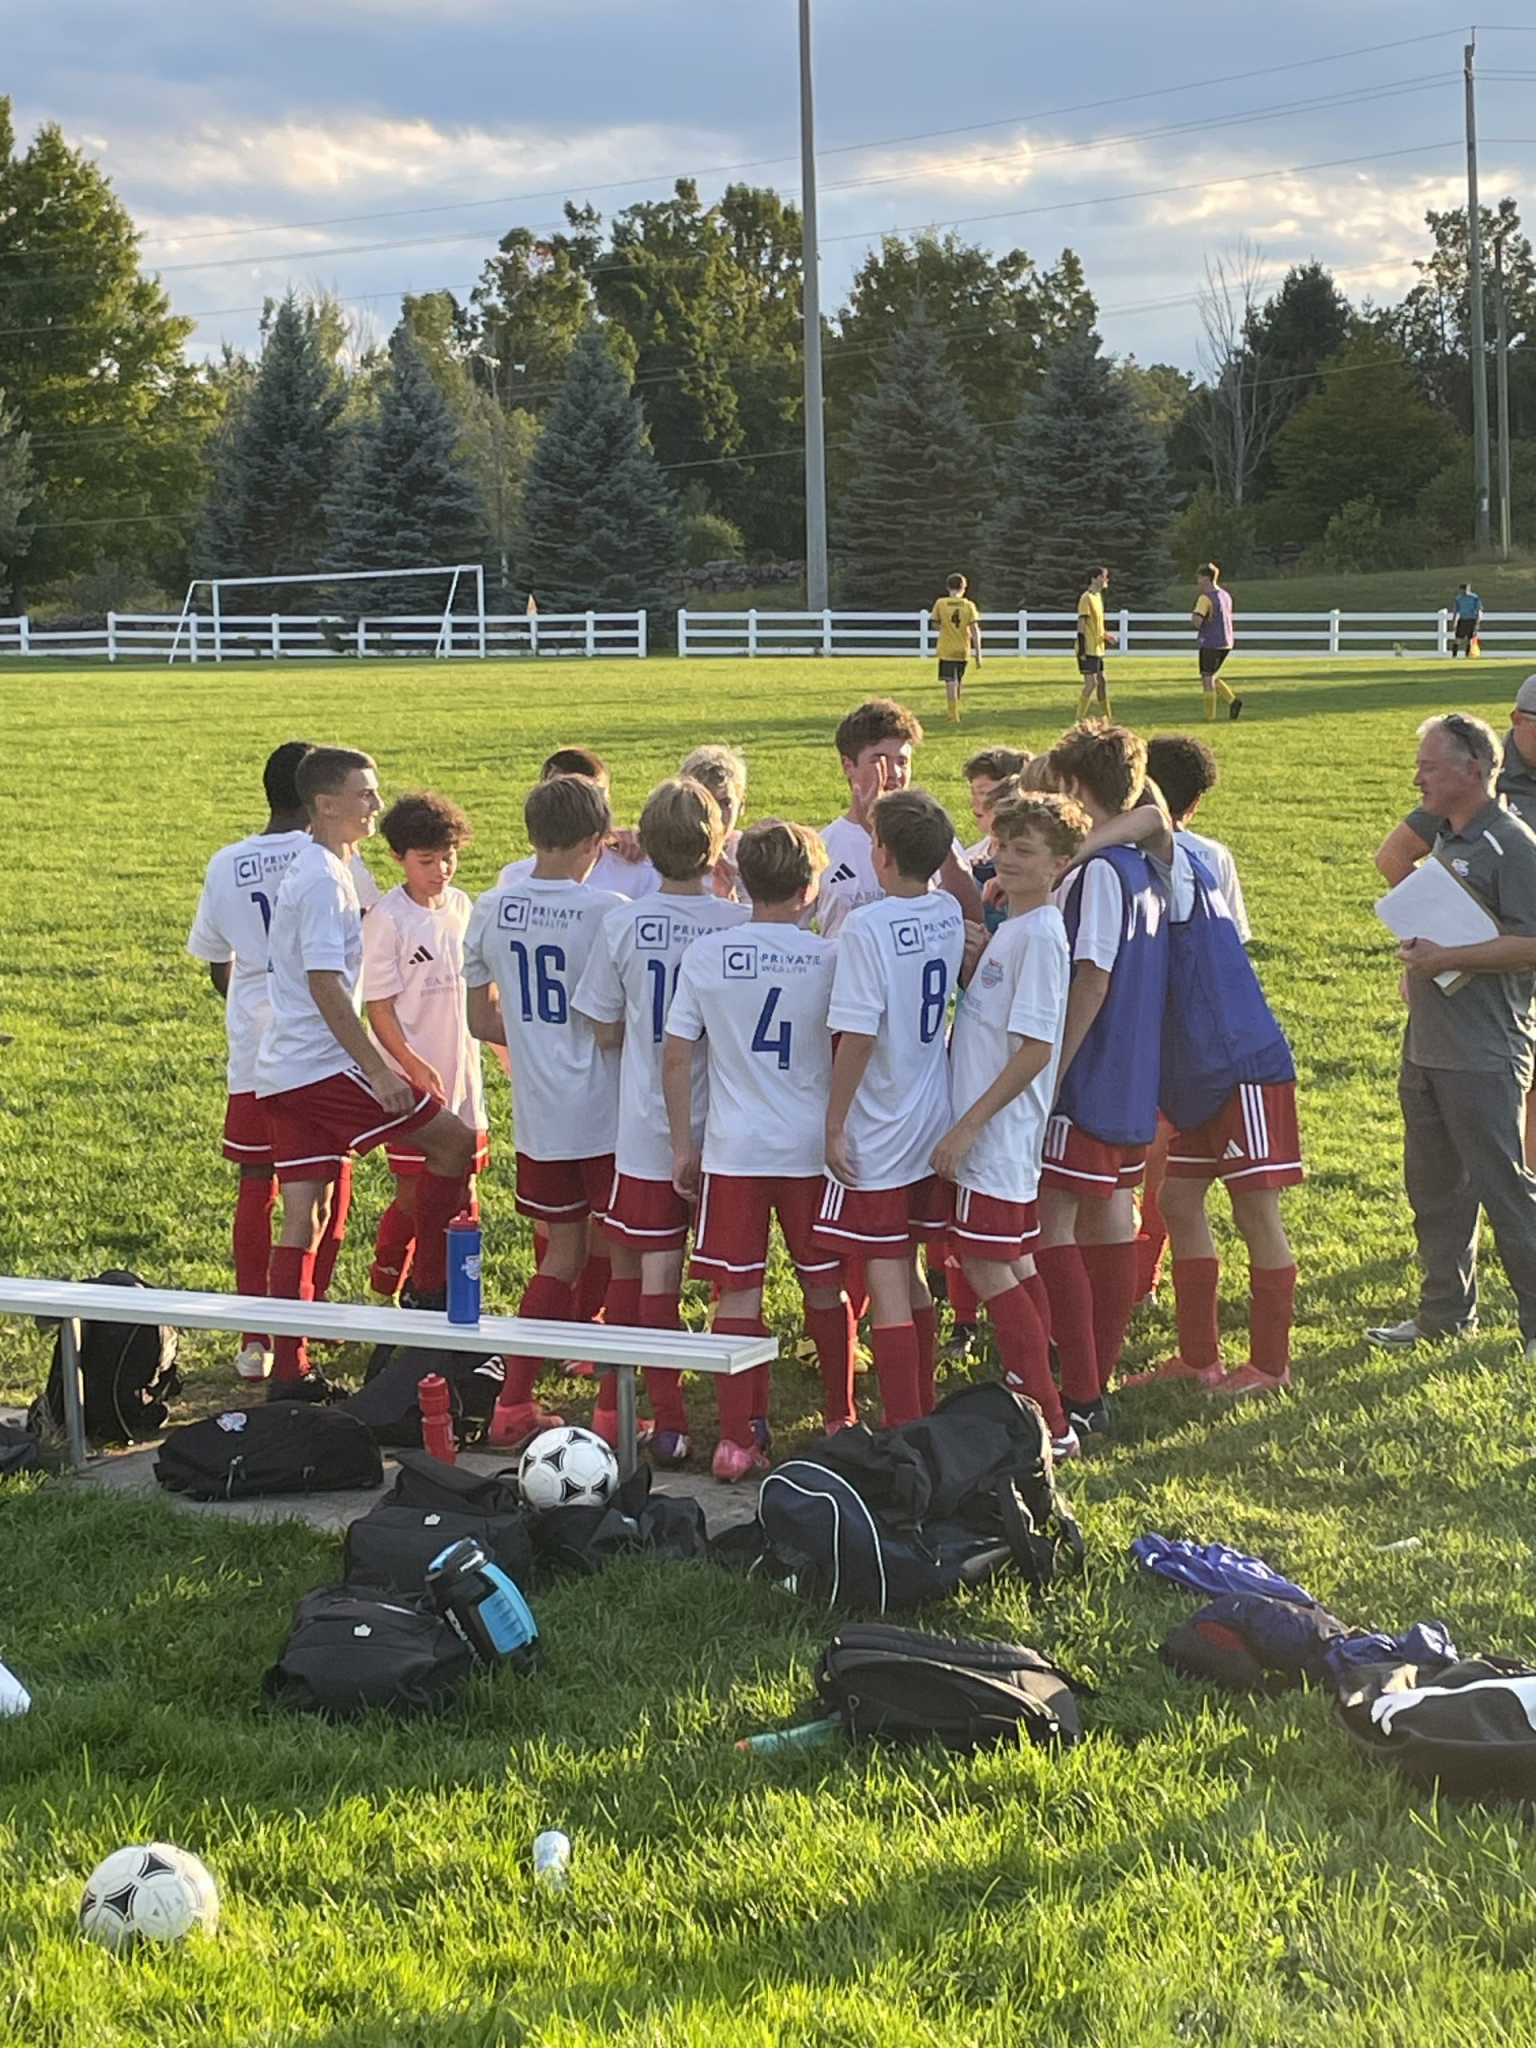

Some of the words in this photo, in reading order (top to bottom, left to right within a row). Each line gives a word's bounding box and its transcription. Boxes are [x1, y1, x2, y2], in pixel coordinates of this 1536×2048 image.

[951, 608, 961, 629] 4
[240, 860, 257, 878] CI
[263, 851, 298, 865] PRIVA
[504, 904, 525, 923] CI
[532, 906, 583, 921] PRIVATE
[640, 923, 663, 942] CI
[898, 926, 920, 947] CI
[728, 952, 751, 971] CI
[761, 953, 822, 966] PRIVATE
[510, 940, 567, 1024] 16
[647, 959, 682, 1044] 1
[920, 958, 947, 1044] 8
[751, 986, 792, 1070] 4
